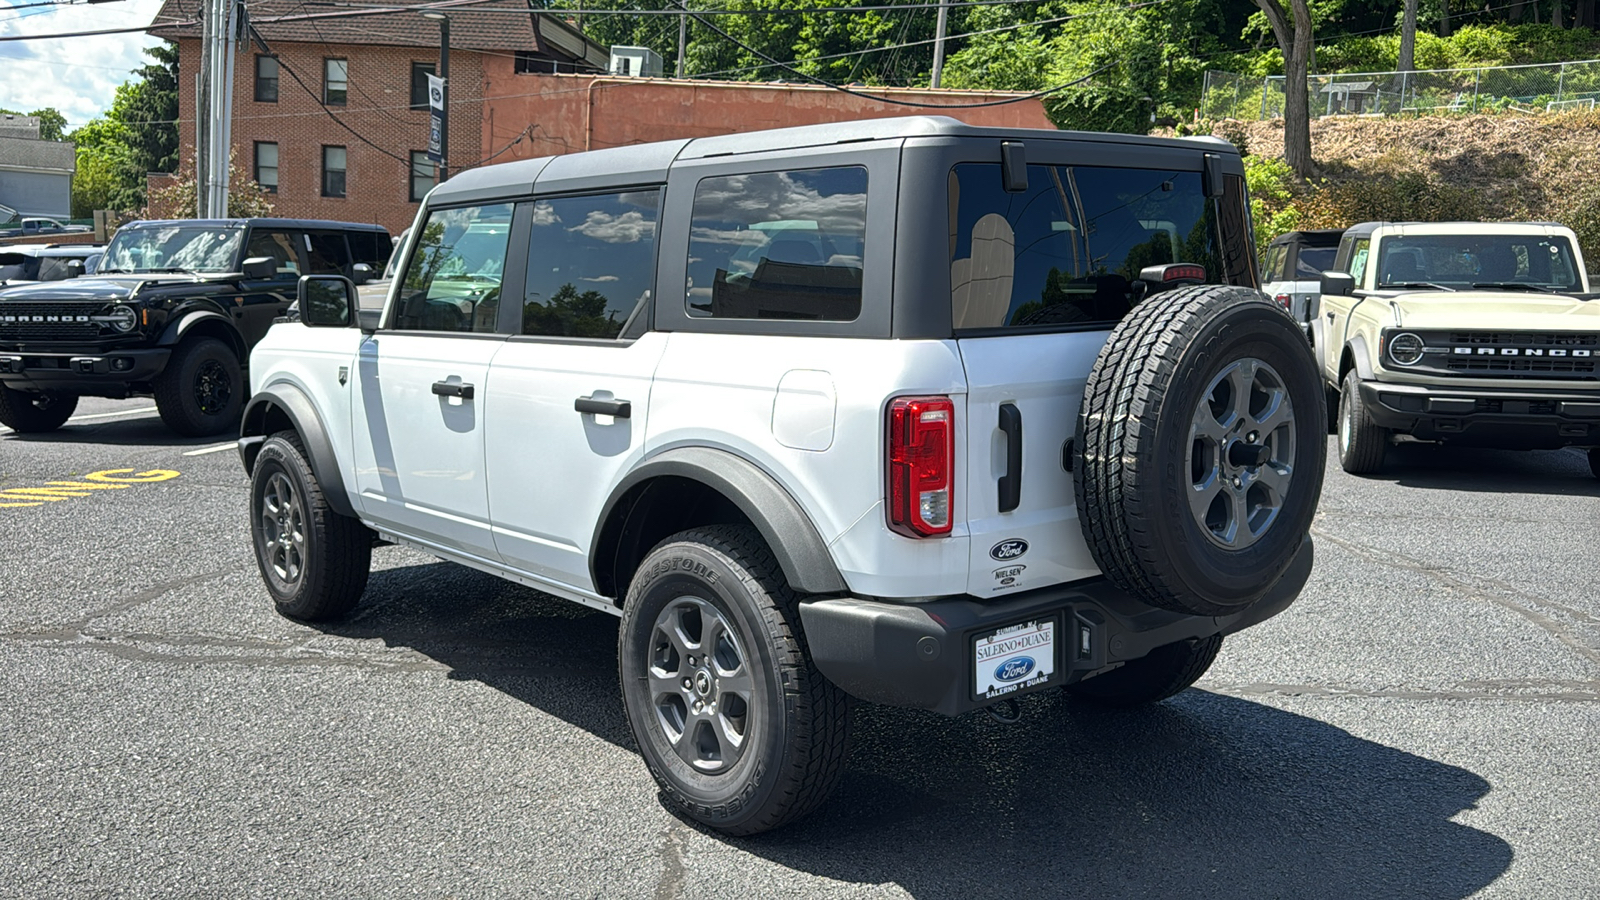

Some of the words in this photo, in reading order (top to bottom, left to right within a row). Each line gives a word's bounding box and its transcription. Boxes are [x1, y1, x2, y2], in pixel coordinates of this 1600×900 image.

[1454, 347, 1590, 357] BRONCO
[998, 542, 1023, 558] Ford
[995, 567, 1021, 580] NIELSEN
[977, 640, 1018, 660] SALERNO
[1021, 631, 1051, 648] DUANE
[1002, 660, 1028, 679] Ford
[985, 684, 1018, 699] SALERNO
[1026, 675, 1049, 687] DUANE
